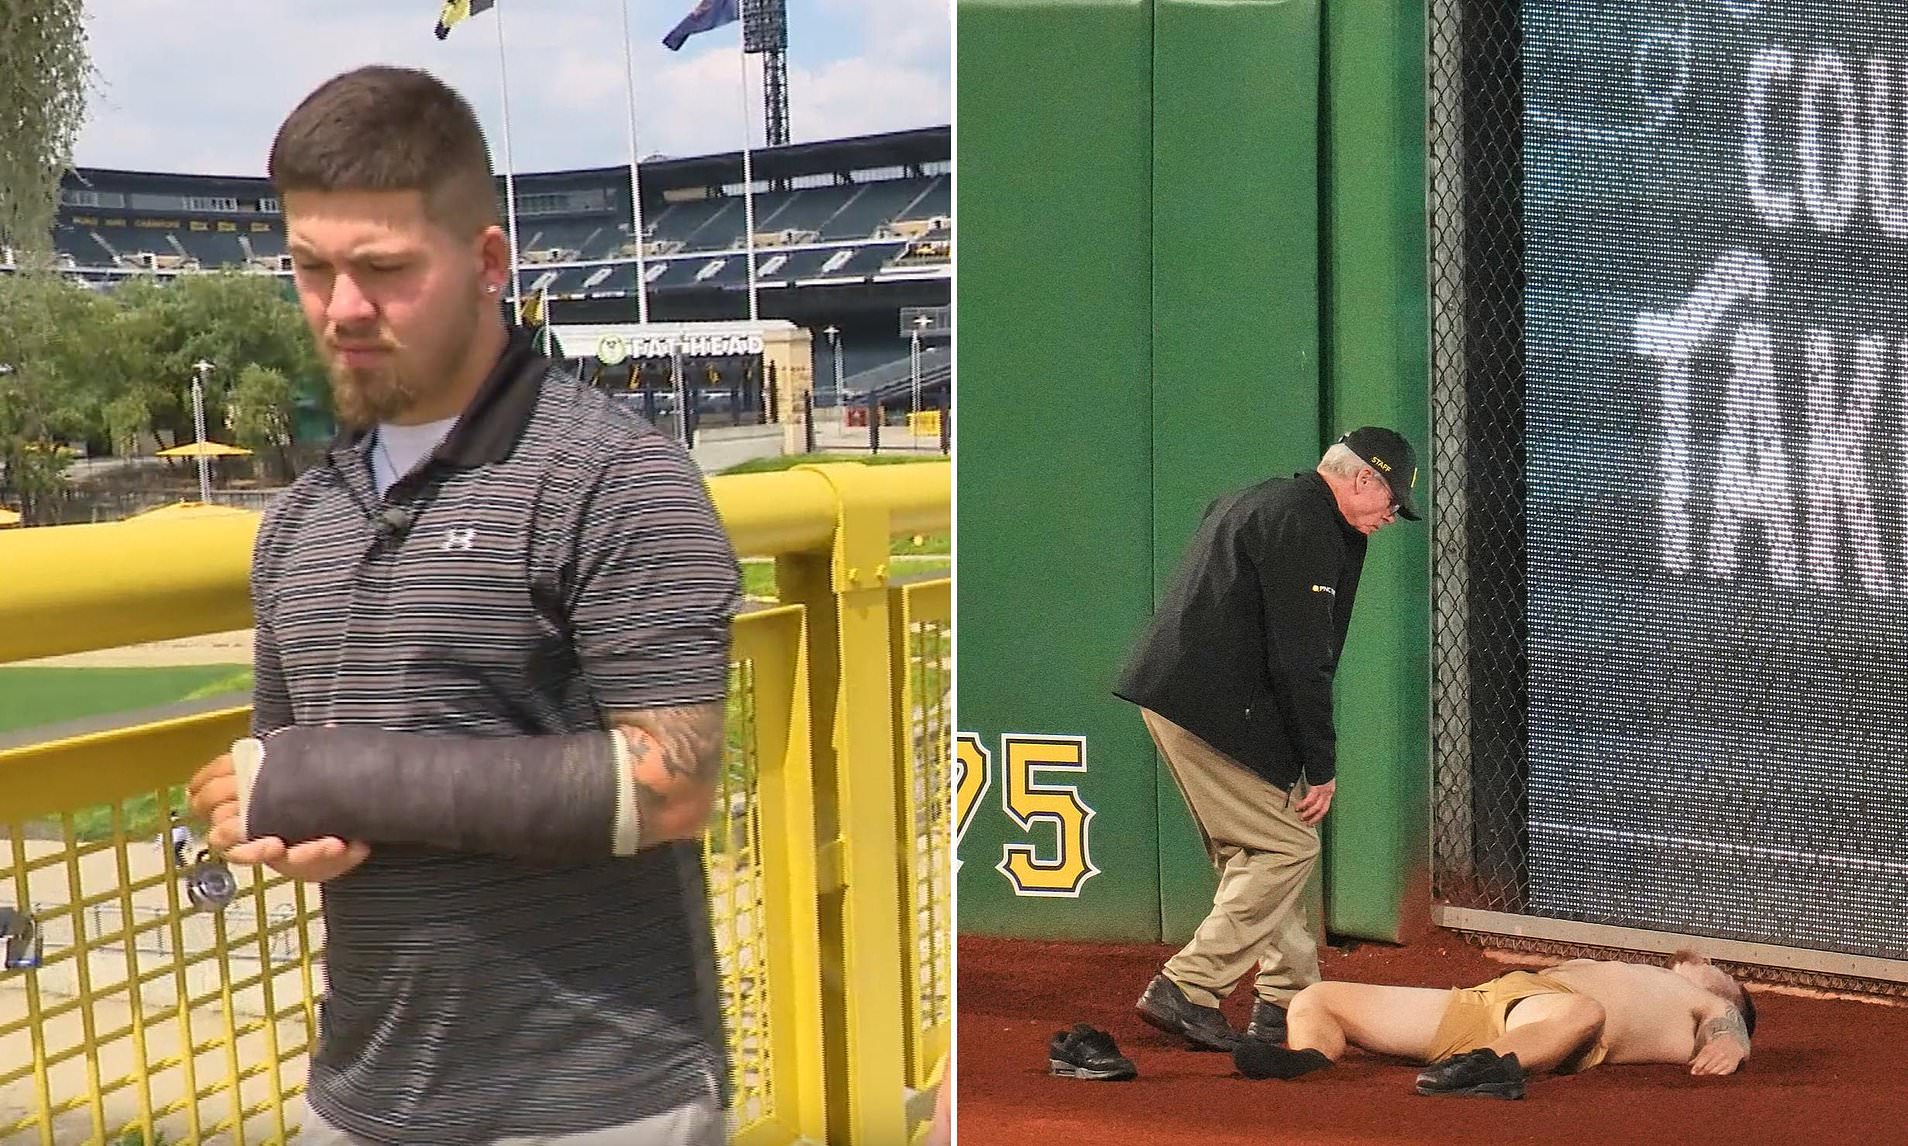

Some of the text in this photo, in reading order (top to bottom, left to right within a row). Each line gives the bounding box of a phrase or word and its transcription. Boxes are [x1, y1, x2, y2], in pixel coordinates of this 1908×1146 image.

[631, 338, 677, 359] FAT
[1632, 246, 1908, 598] TAK
[1371, 456, 1392, 473] STAFF
